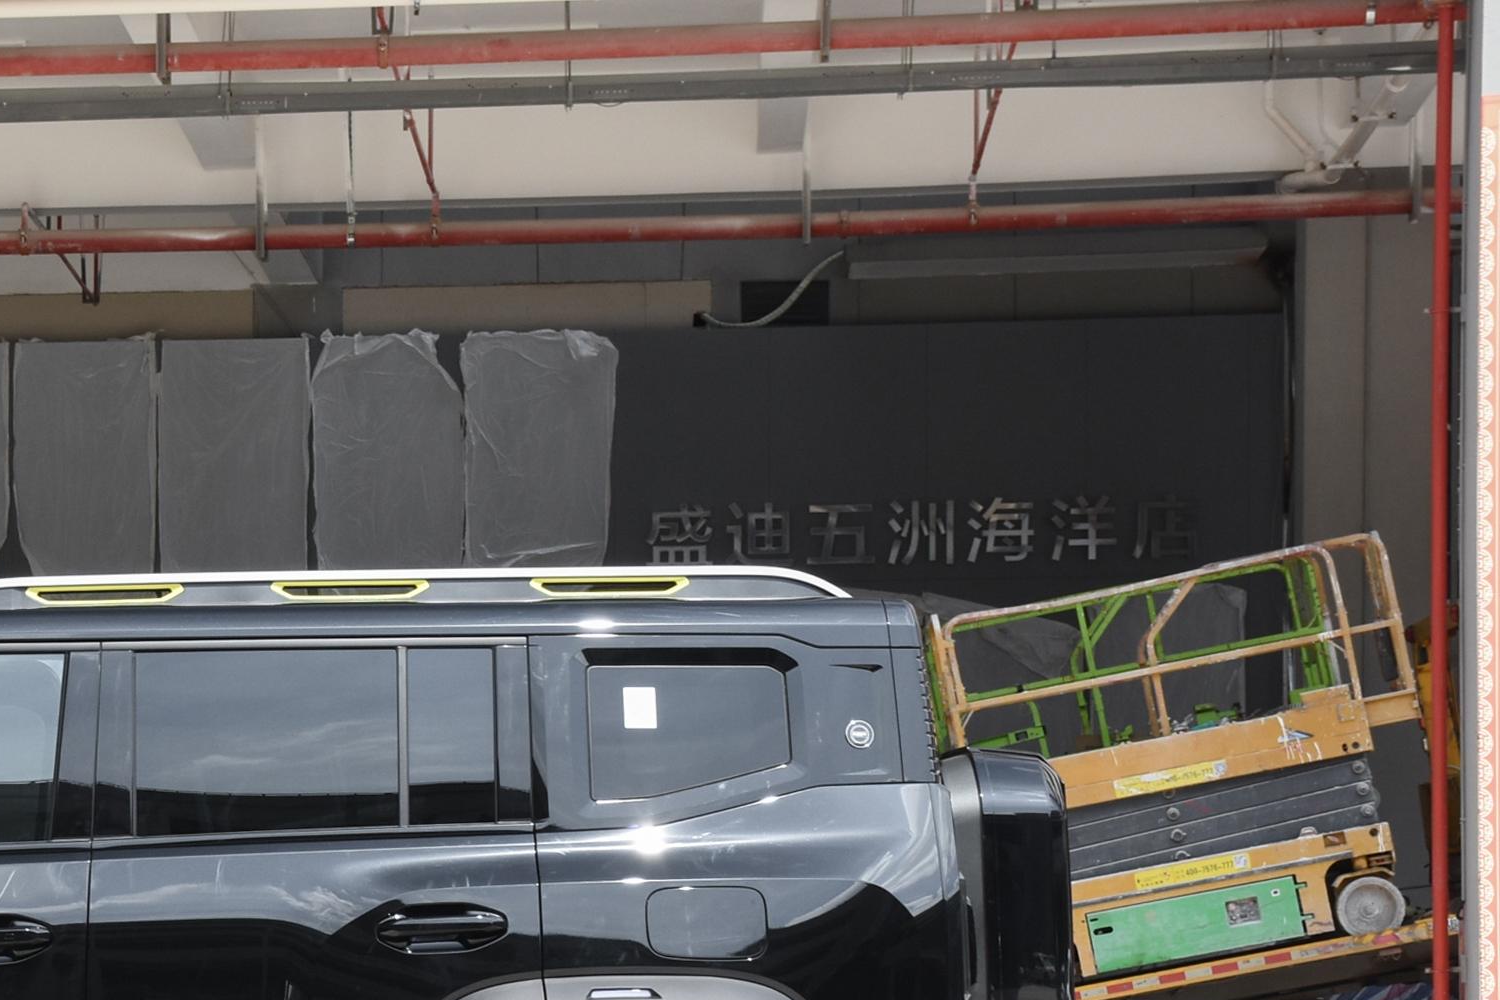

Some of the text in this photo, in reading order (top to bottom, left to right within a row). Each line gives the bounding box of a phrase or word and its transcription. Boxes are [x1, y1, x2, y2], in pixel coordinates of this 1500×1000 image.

[645, 496, 1198, 566] 盛迪五洲海洋店
